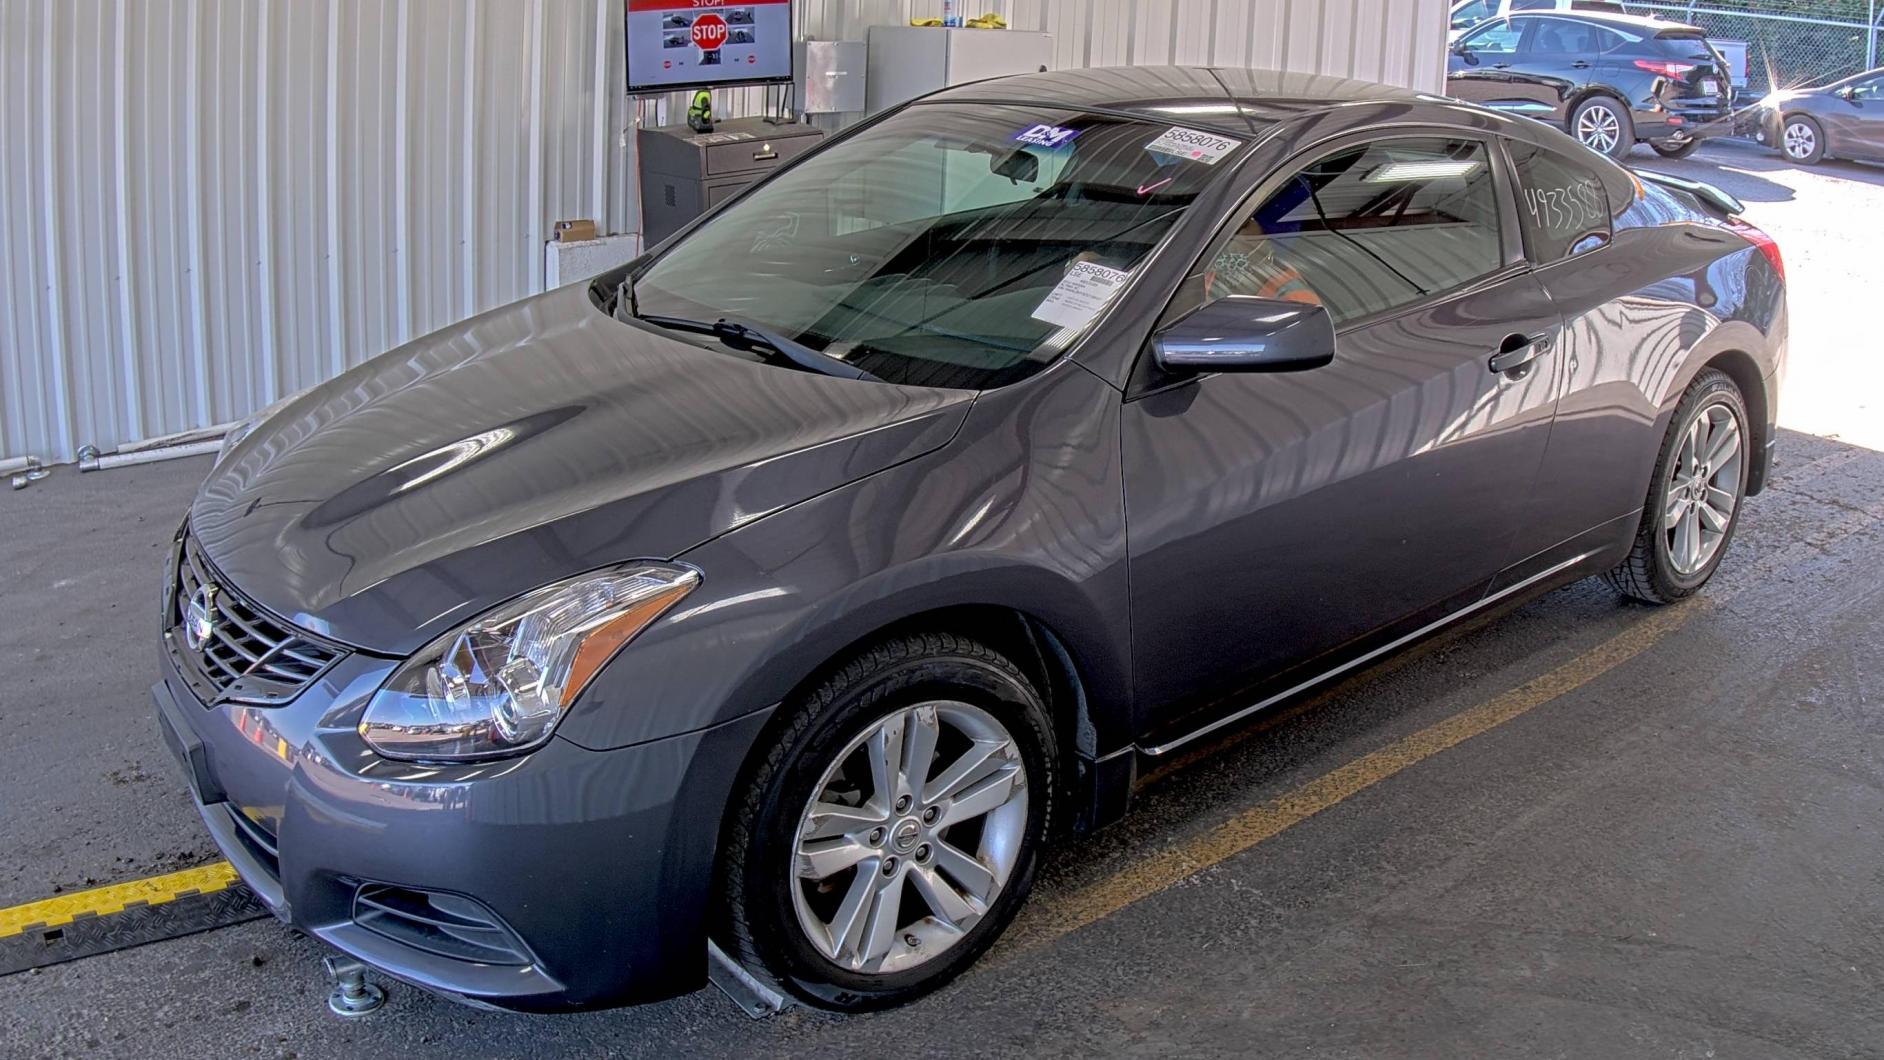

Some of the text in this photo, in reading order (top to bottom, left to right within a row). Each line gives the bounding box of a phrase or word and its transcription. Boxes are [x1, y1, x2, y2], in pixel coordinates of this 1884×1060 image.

[693, 24, 726, 40] STOP
[1016, 135, 1055, 147] LEASING
[1164, 129, 1231, 151] 5858076
[1073, 262, 1127, 283] 5858076
